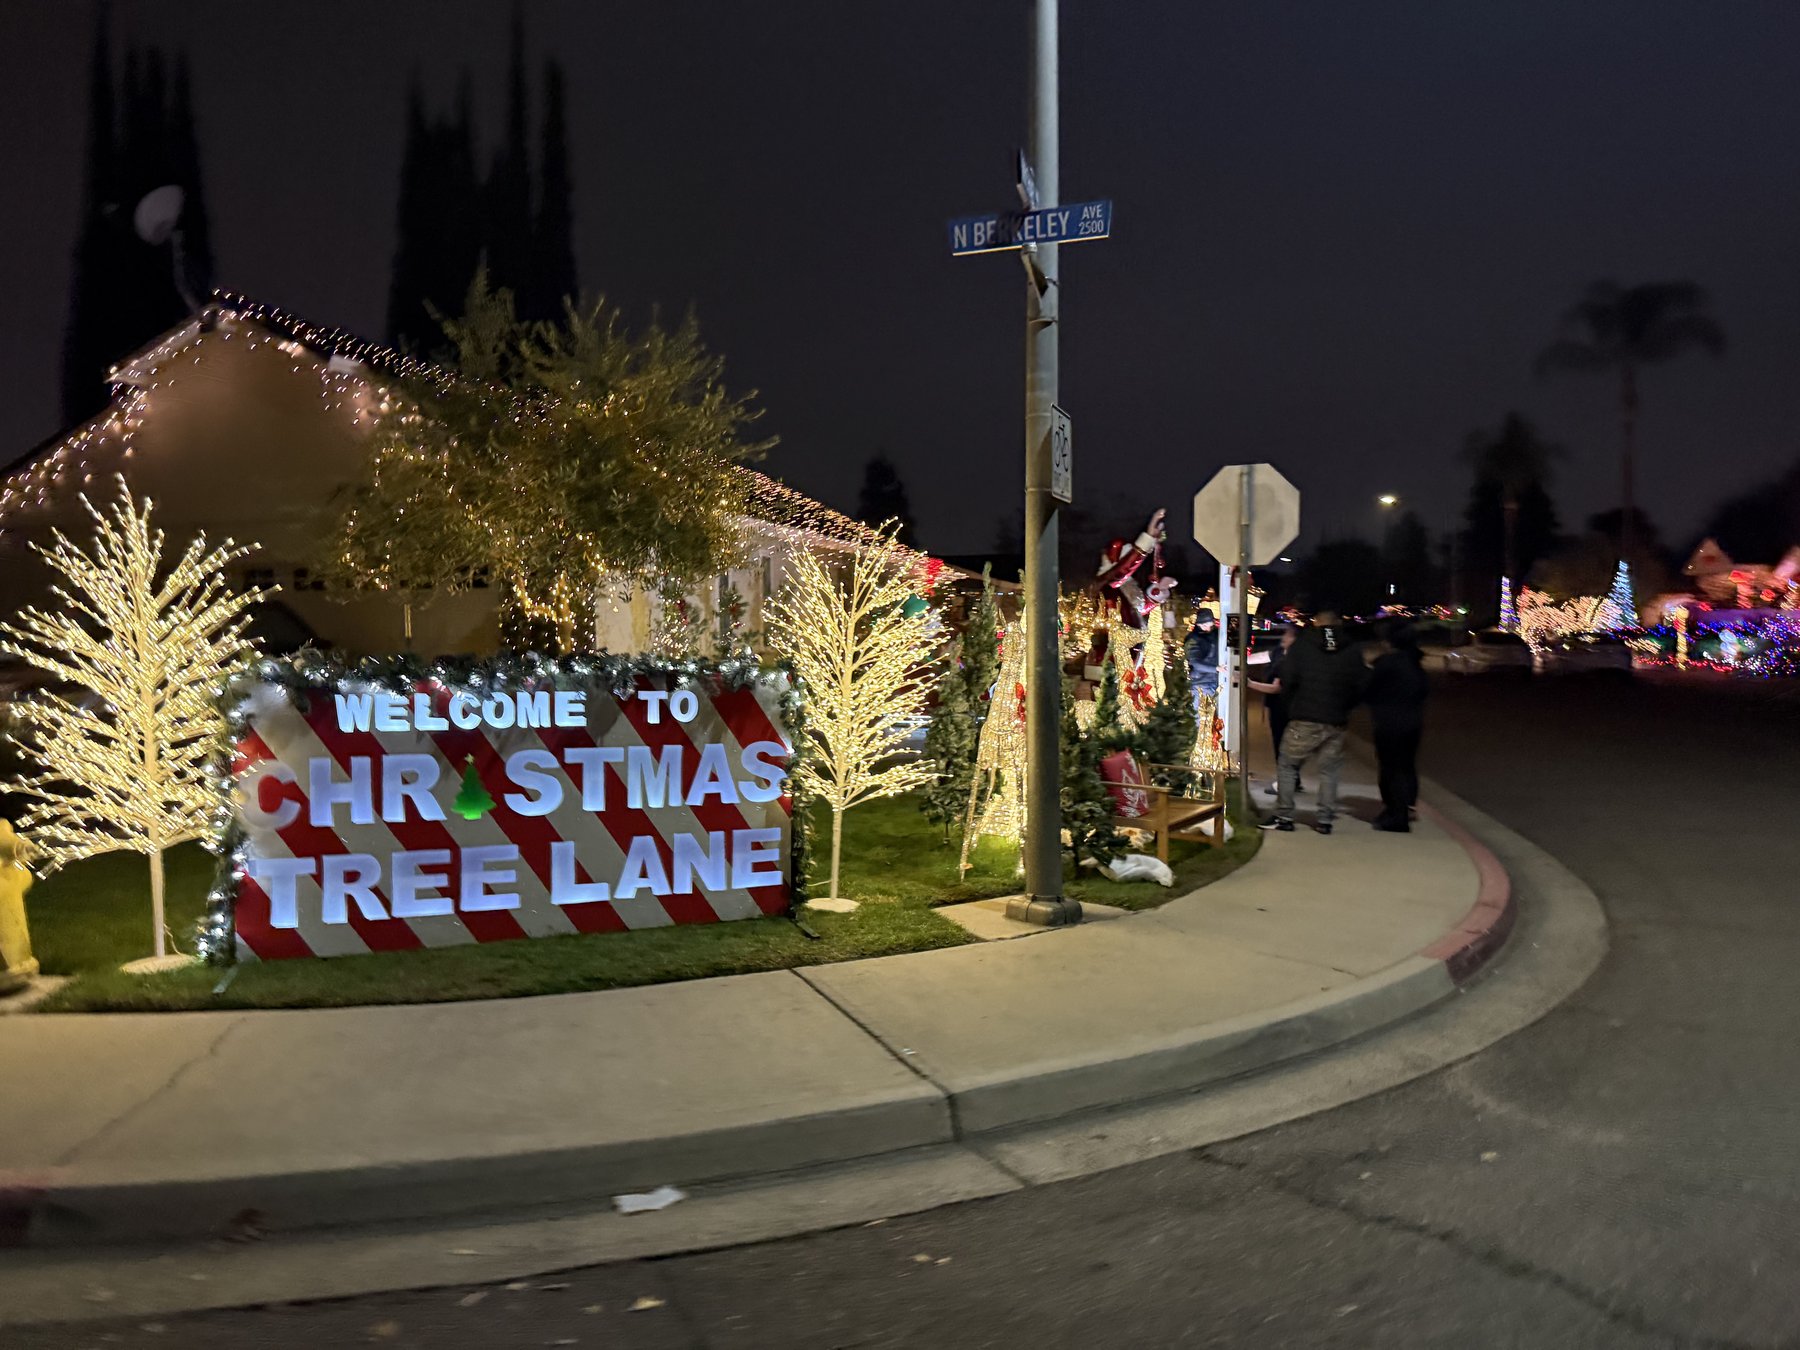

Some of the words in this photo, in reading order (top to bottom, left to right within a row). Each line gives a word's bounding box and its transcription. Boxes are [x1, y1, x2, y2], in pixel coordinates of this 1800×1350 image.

[954, 224, 967, 249] N
[1082, 205, 1103, 219] AVE
[1079, 220, 1104, 235] 2500
[336, 690, 587, 733] WELCOME
[639, 690, 699, 725] TO
[240, 741, 789, 831] CHRSTMAS
[250, 845, 520, 929] TREE
[551, 828, 783, 905] LANE
